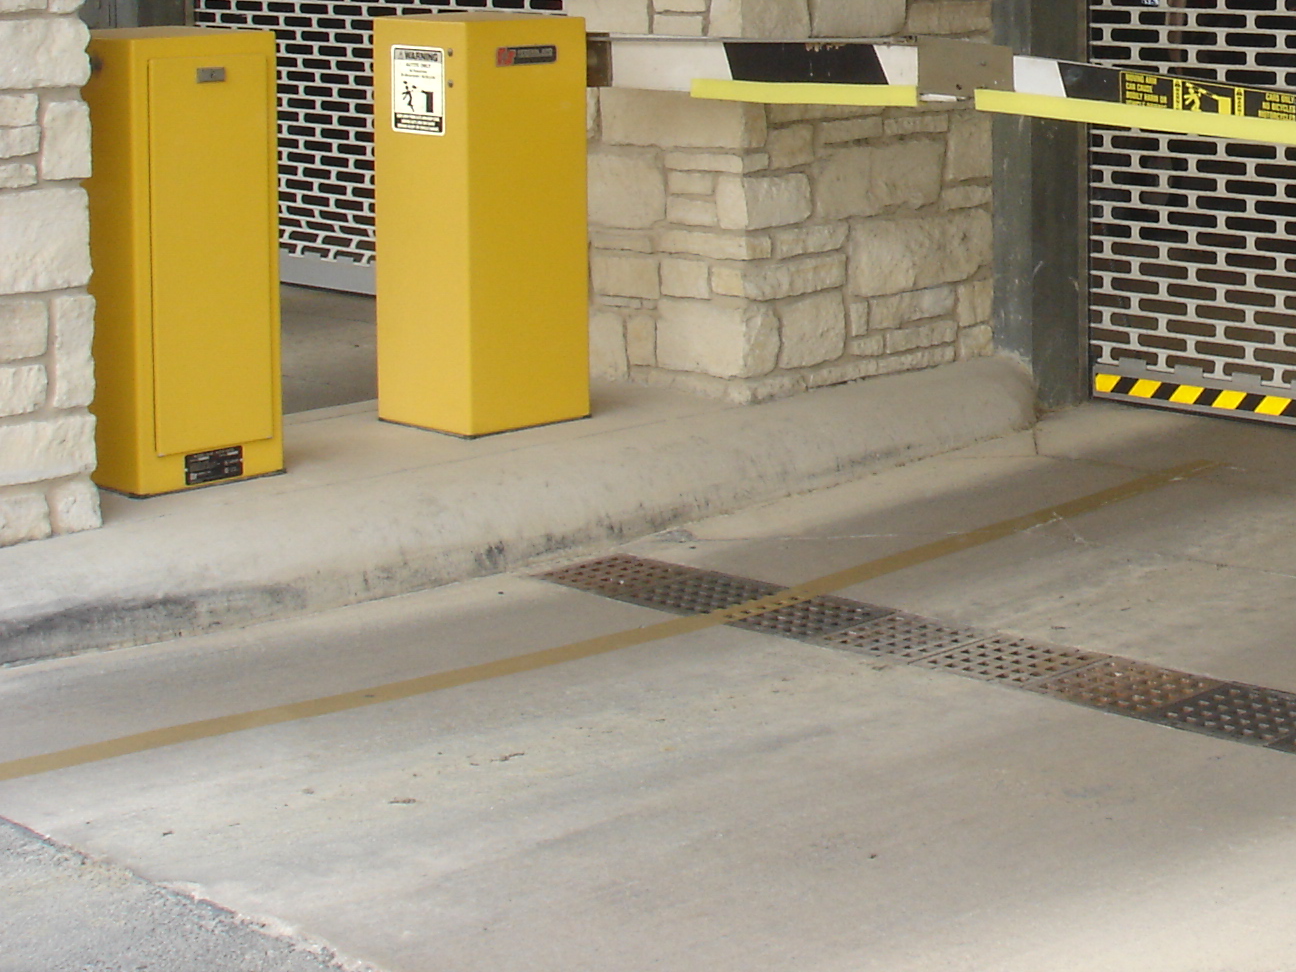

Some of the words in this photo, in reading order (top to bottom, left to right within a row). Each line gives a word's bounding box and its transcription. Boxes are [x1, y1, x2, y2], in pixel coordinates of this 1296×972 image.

[405, 51, 438, 62] WARNING
[1145, 76, 1157, 85] ARM
[1125, 82, 1136, 91] CAN
[1136, 83, 1153, 93] CAUSE
[1125, 90, 1143, 101] BODILY
[1144, 93, 1158, 103] HARM
[1159, 95, 1168, 104] OR
[1280, 94, 1296, 104] ONLY
[1262, 101, 1271, 110] NO
